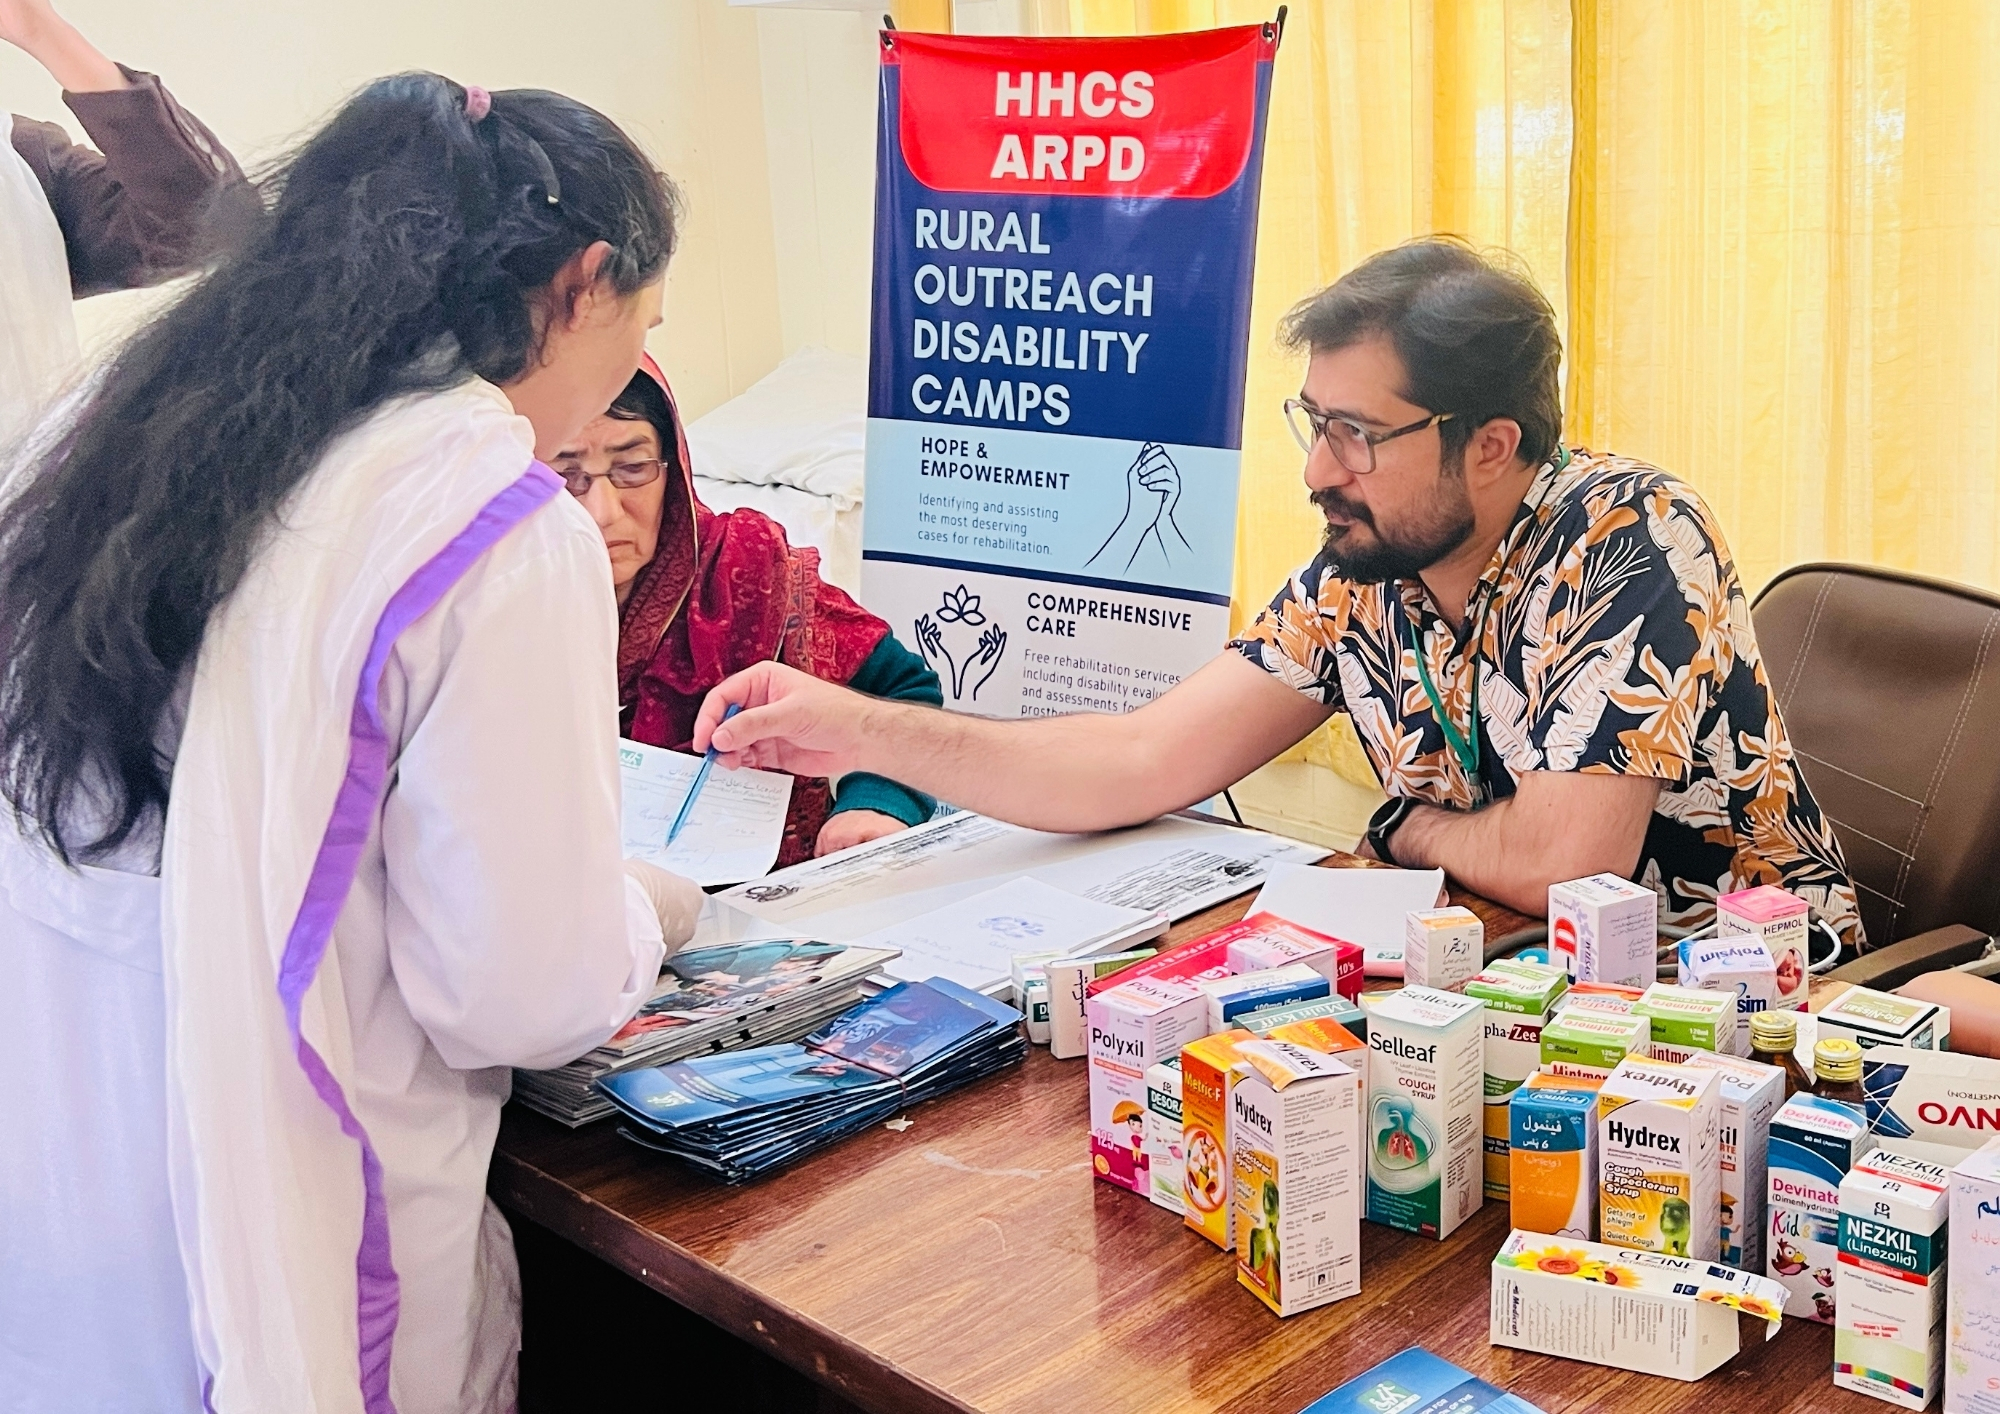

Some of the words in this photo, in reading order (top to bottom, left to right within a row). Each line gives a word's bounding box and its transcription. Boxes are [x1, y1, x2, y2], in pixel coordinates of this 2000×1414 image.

[995, 71, 1155, 118] HHCS
[990, 134, 1146, 183] ARPD
[915, 208, 1051, 254] RURAL
[914, 264, 1153, 317] OUTREACH
[913, 319, 1149, 374] DISABILITY
[911, 374, 1070, 426] CAMPS
[921, 437, 969, 457] HOPE
[976, 443, 988, 459] &
[921, 459, 1070, 490] EMPOWERMENT
[919, 493, 979, 514] Identifying
[983, 500, 1004, 514] and
[1007, 502, 1059, 523] assisting
[919, 512, 937, 525] the
[941, 514, 968, 528] most
[971, 516, 1027, 537] deserving
[918, 530, 948, 543] cases
[952, 532, 969, 545] for
[973, 534, 1053, 556] rehabilitation.
[1027, 592, 1191, 631] COMPREHENSIVE
[1026, 616, 1076, 637] CARE
[1024, 649, 1050, 664] Free
[1053, 653, 1130, 678] rehabilitation
[1134, 667, 1181, 685] services
[1023, 668, 1073, 690] including
[1077, 675, 1129, 697] disability
[1022, 686, 1042, 699] and
[1046, 689, 1118, 712] assessments
[1764, 918, 1804, 935] HEPMOL
[1700, 947, 1765, 964] Polysim
[1126, 981, 1186, 1003] Polyxil
[1399, 990, 1470, 1010] Selleaf
[1260, 1010, 1299, 1028] Kuff
[1299, 1002, 1346, 1020] Multi
[1505, 1001, 1525, 1012] Syrup
[1652, 999, 1713, 1014] Mintmore
[1842, 1003, 1906, 1024] Bio-Nissan
[1484, 1023, 1537, 1043] pha-Zee
[1563, 1018, 1627, 1035] Mintmore
[1092, 1027, 1144, 1058] Polyxil
[1370, 1032, 1437, 1064] Selleaf
[1651, 1045, 1693, 1064] intmo
[1274, 1041, 1323, 1072] Hydrex
[1184, 1070, 1221, 1102] Metric-F
[1398, 1077, 1436, 1092] COUGH
[1412, 1090, 1436, 1100] SYRUP
[1621, 1069, 1697, 1096] Hydrex
[1235, 1093, 1272, 1136] Hydrex
[1783, 1108, 1853, 1130] Devinate
[1608, 1120, 1681, 1154] Hydrex
[1605, 1162, 1644, 1177] Cough
[1868, 1159, 1943, 1185] (Linezolid)
[1873, 1152, 1947, 1177] NEZKIL
[1605, 1172, 1679, 1195] Expectorant
[1605, 1183, 1640, 1199] Syrup
[1773, 1178, 1839, 1206] Devinate
[1607, 1207, 1623, 1217] Gets
[1626, 1211, 1636, 1219] rid
[1607, 1216, 1633, 1227] phlegm
[1606, 1230, 1629, 1241] Quiets
[1632, 1236, 1655, 1248] Cough
[1847, 1218, 1918, 1254] NEZKIL
[1619, 1251, 1698, 1271] CTZINE
[1847, 1238, 1918, 1270] (Linezolid)
